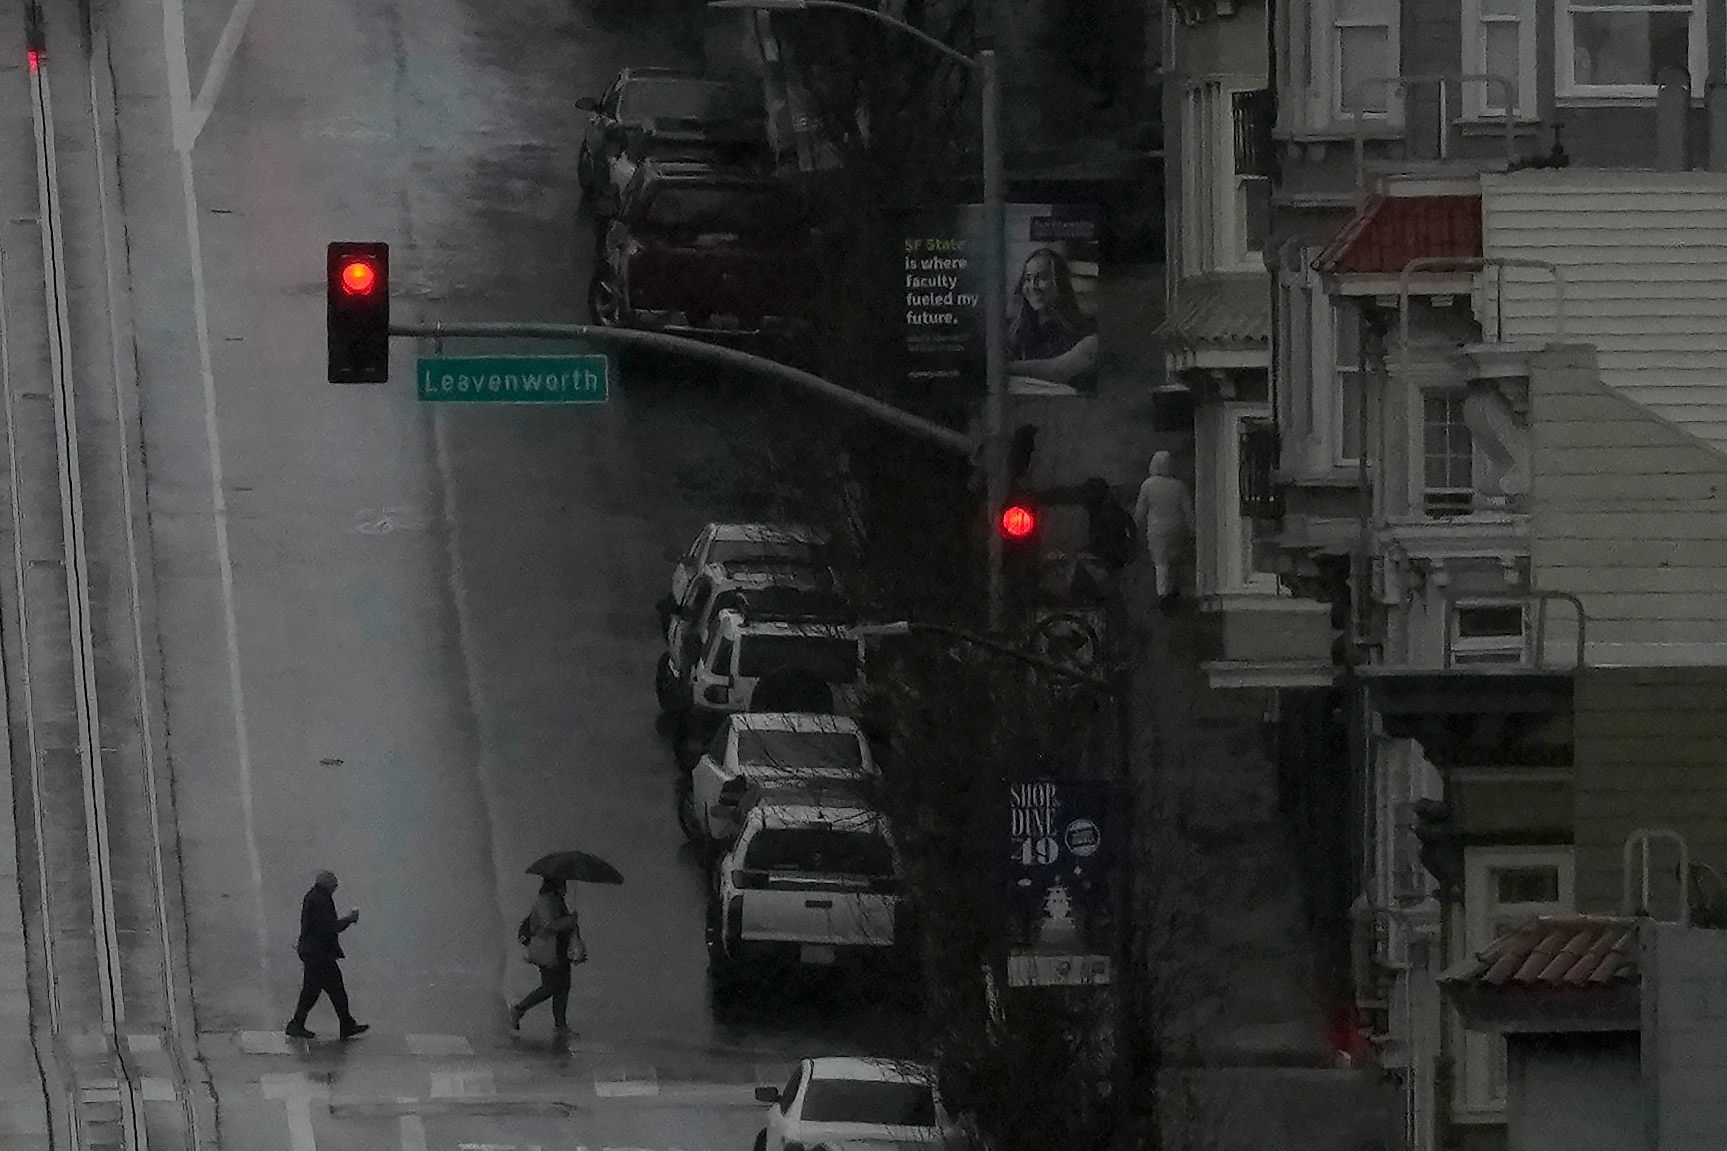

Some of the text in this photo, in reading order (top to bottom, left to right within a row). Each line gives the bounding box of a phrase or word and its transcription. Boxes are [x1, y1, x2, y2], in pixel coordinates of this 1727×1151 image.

[904, 239, 922, 252] SF
[920, 255, 968, 269] where
[906, 274, 958, 290] faculty
[906, 292, 979, 308] fueled my
[906, 311, 958, 325] future.
[425, 368, 598, 393] Leavenworth
[1010, 836, 1059, 865] 49
